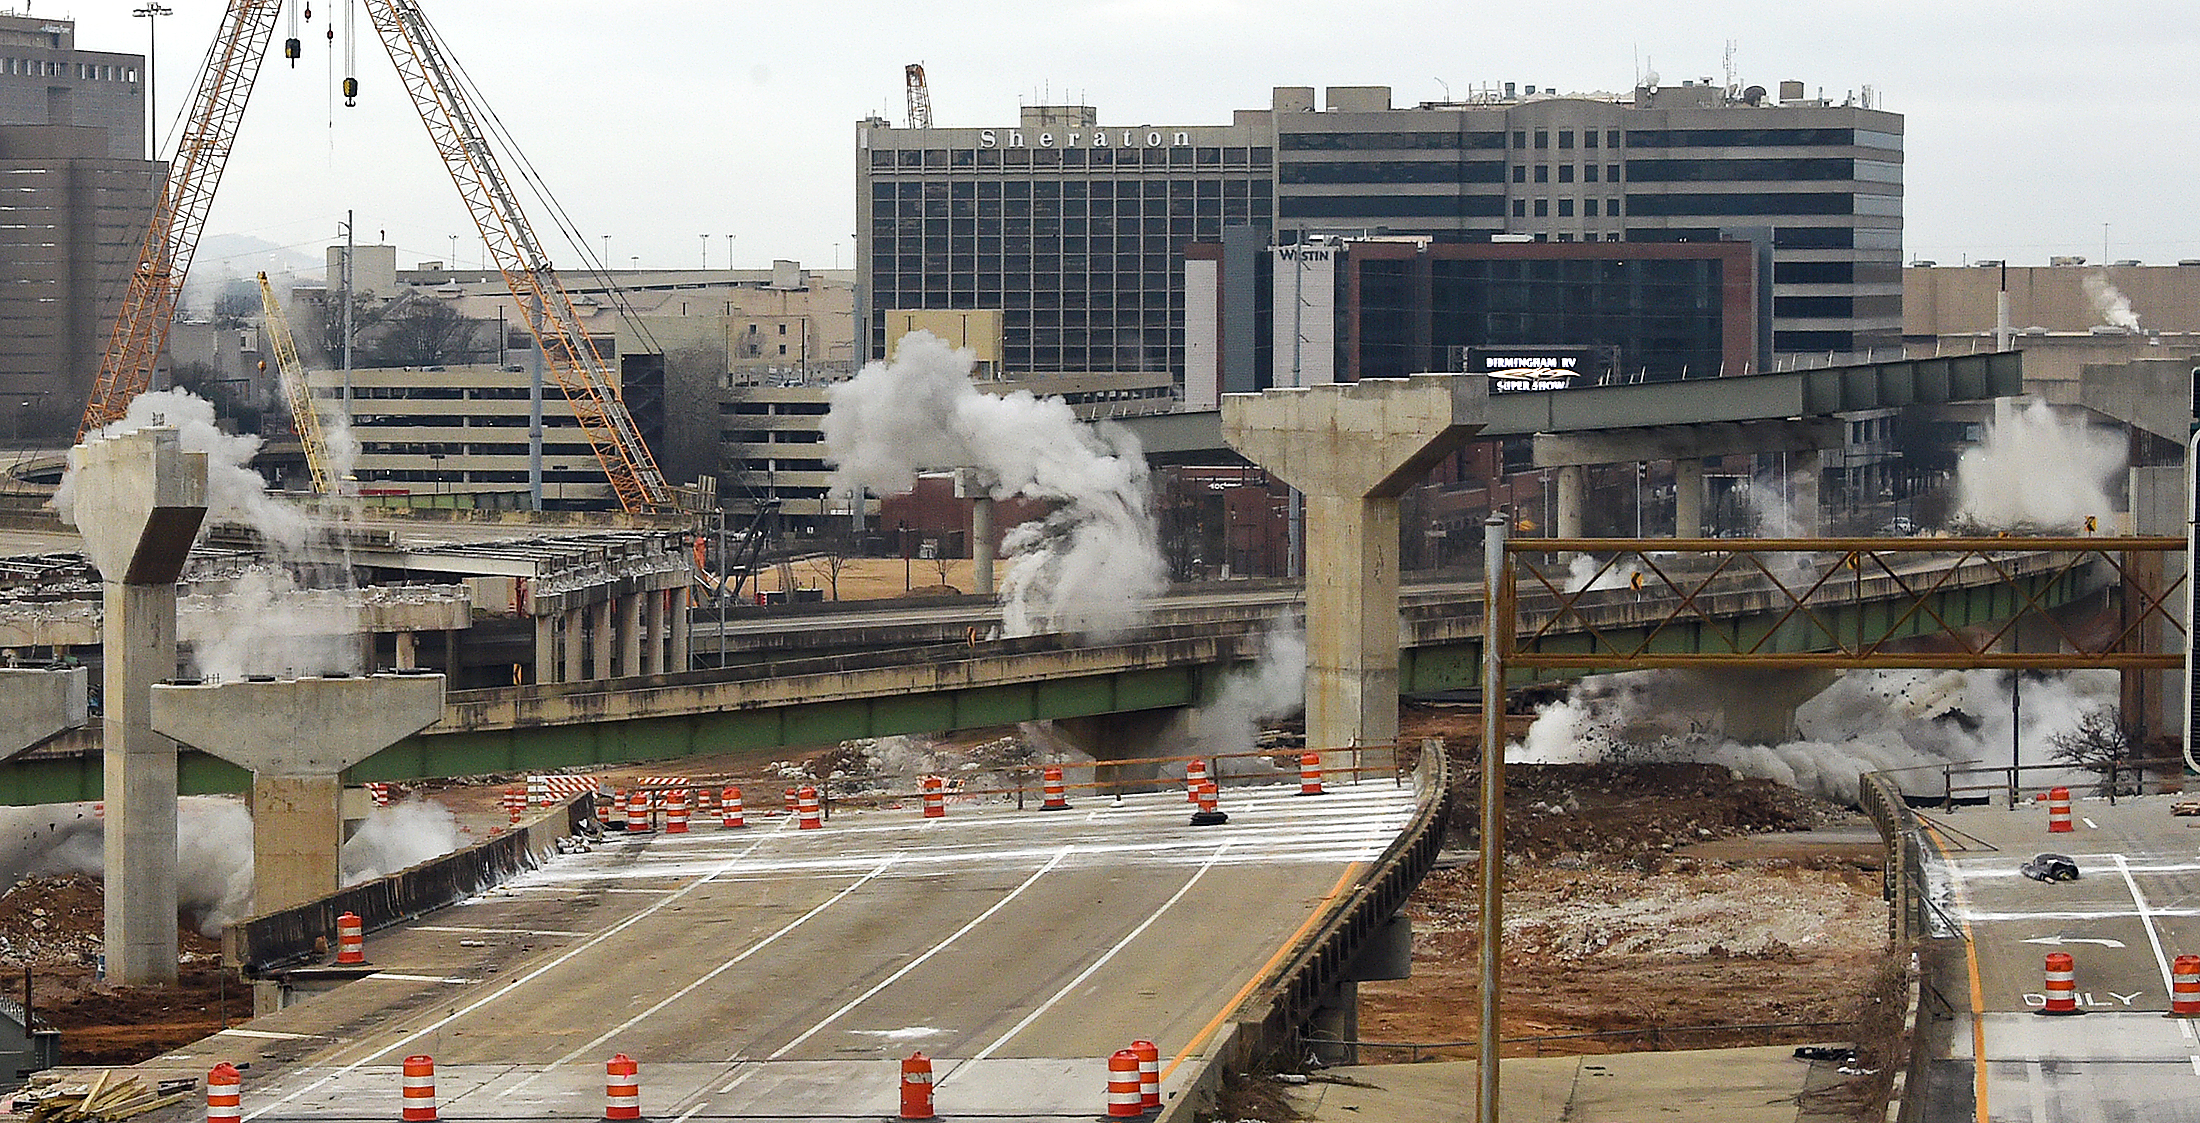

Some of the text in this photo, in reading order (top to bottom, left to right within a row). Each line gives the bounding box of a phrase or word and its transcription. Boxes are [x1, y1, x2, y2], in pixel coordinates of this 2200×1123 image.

[980, 129, 1190, 148] Sheraton
[1486, 357, 1577, 368] BIRMINGHAM RV
[1496, 380, 1566, 391] SUPER SHOW
[2022, 991, 2143, 1006] OLY
